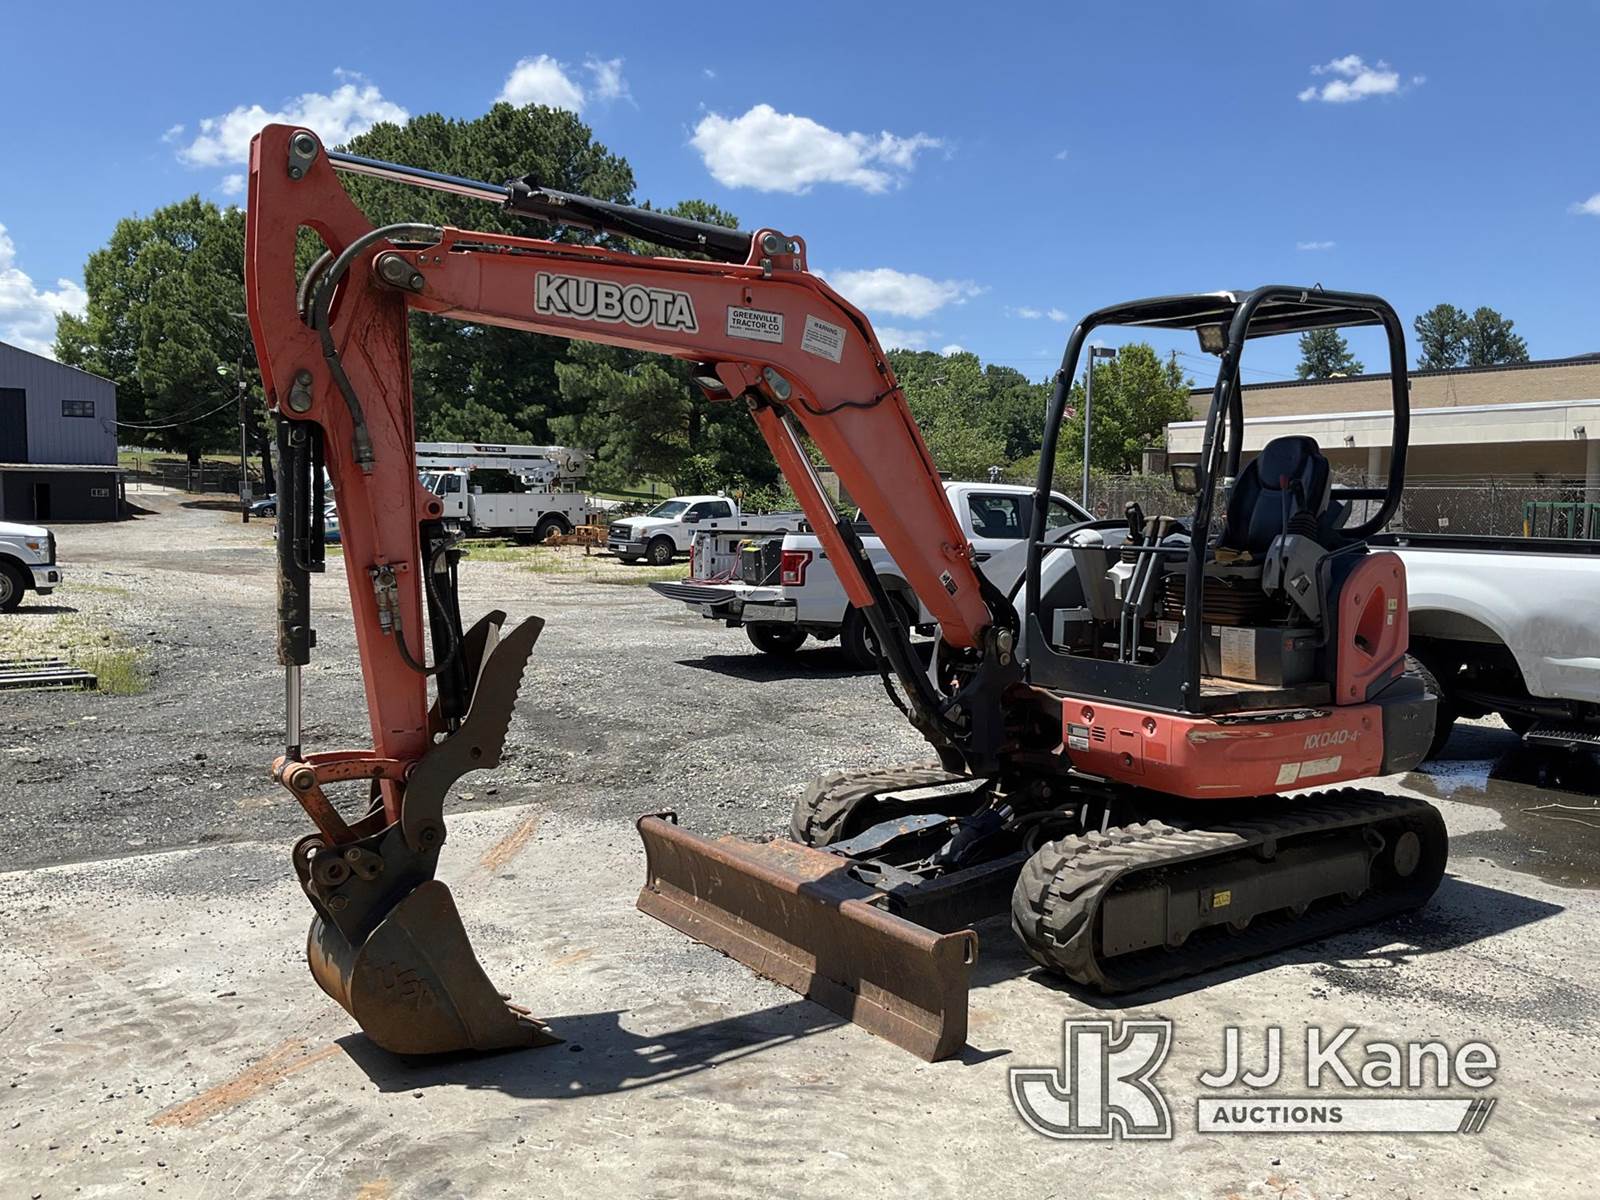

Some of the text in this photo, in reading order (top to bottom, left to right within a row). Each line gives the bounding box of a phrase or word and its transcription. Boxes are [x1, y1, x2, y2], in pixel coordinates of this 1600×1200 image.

[536, 272, 697, 331] KUBOTA
[732, 317, 767, 329] TRACTOR
[768, 323, 780, 331] CO
[733, 310, 779, 324] GREENVILLE
